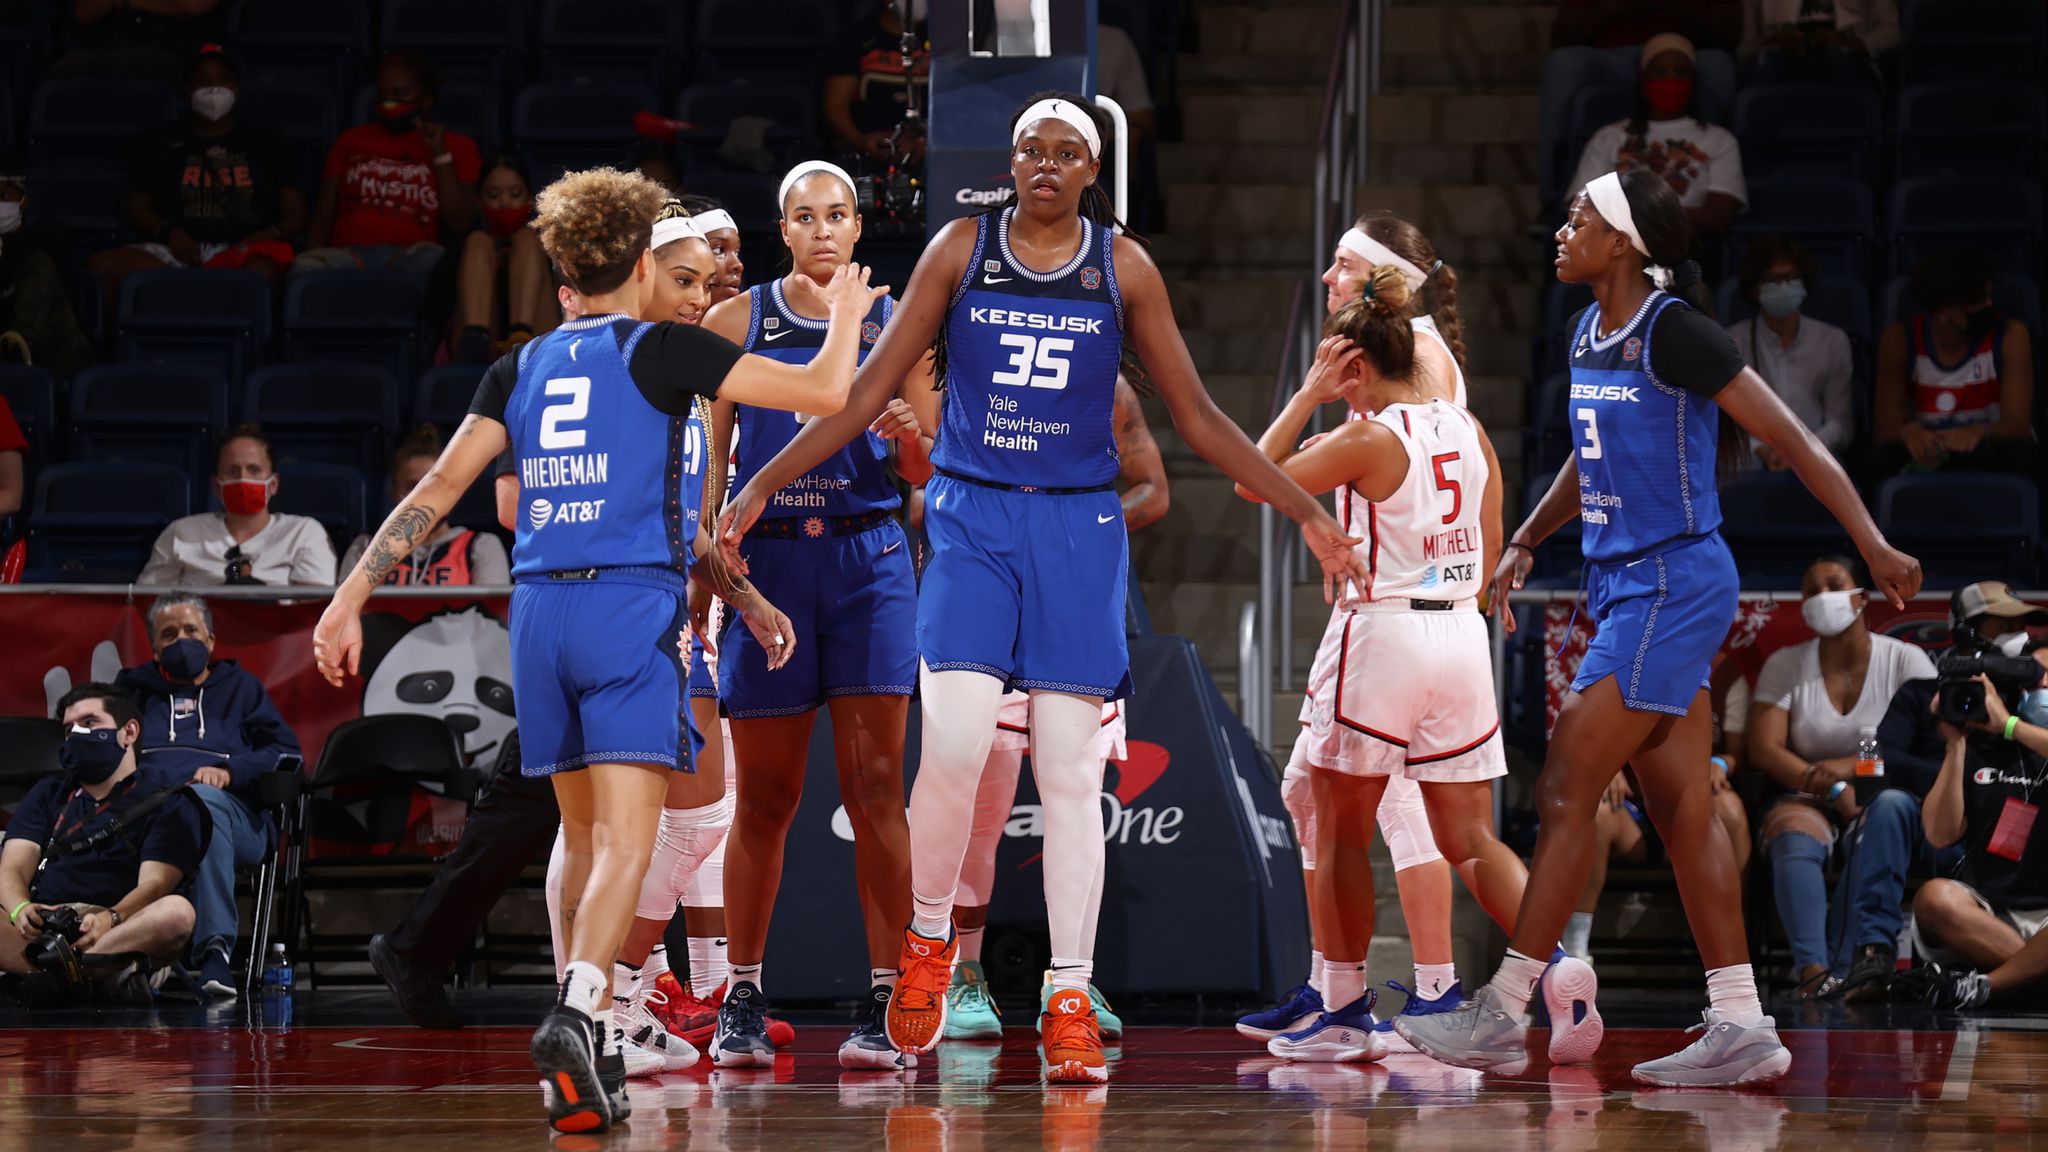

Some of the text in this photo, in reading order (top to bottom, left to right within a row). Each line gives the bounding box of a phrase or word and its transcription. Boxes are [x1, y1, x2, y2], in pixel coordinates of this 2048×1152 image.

[182, 165, 254, 188] RISE
[955, 187, 1017, 204] Capit
[971, 307, 1103, 334] KEESUSK
[992, 333, 1074, 390] 35
[988, 393, 1018, 412] Yale
[1570, 383, 1640, 402] EESUSK
[540, 376, 591, 449] 2
[986, 411, 1070, 435] NewHaven
[983, 430, 1038, 451] Health
[1577, 408, 1602, 459] 3
[522, 453, 608, 488] HIEDEMAN
[785, 474, 852, 490] ewHaven
[773, 490, 826, 507] Health
[1431, 451, 1461, 525] 5
[554, 499, 606, 523] AT&T
